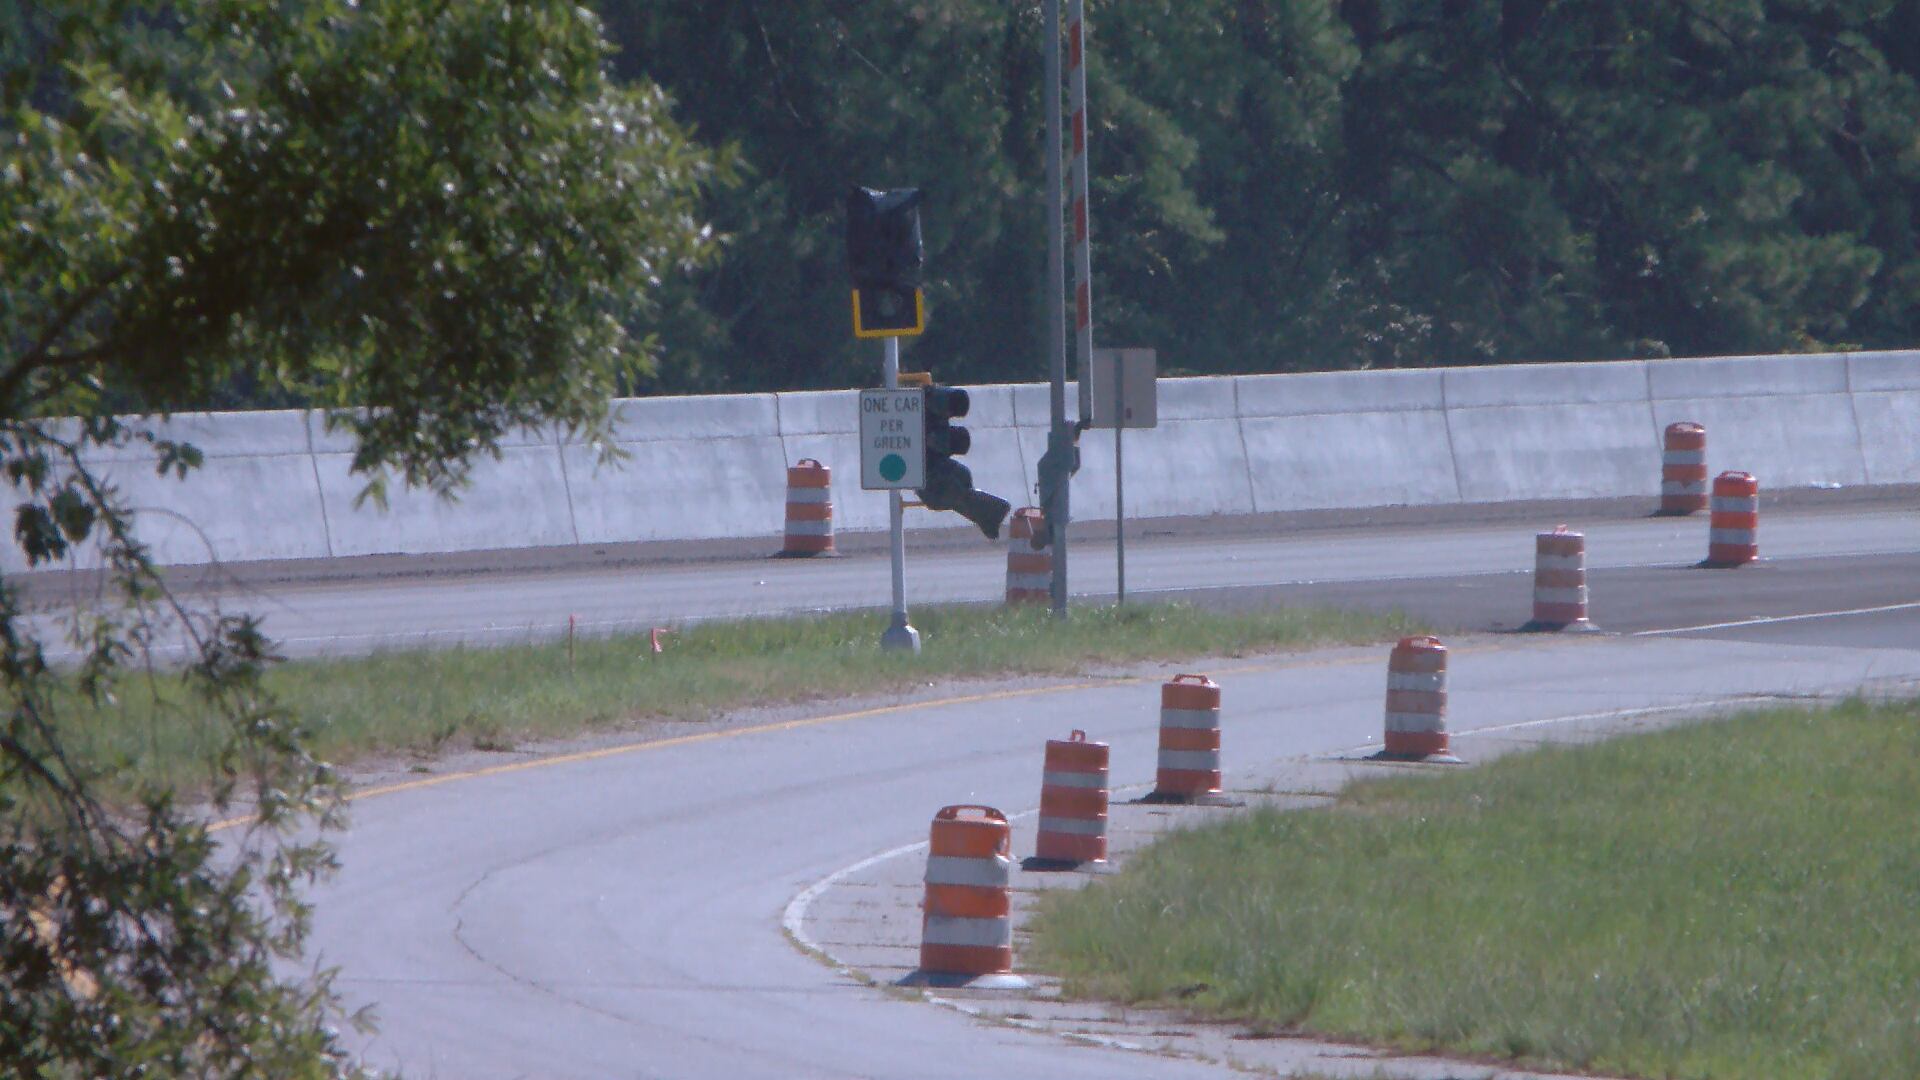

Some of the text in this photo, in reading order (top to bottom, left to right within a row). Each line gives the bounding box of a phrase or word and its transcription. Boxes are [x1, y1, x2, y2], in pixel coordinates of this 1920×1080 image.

[864, 397, 920, 412] ONE CAR
[880, 419, 903, 432] PER
[874, 436, 911, 448] GREEN
